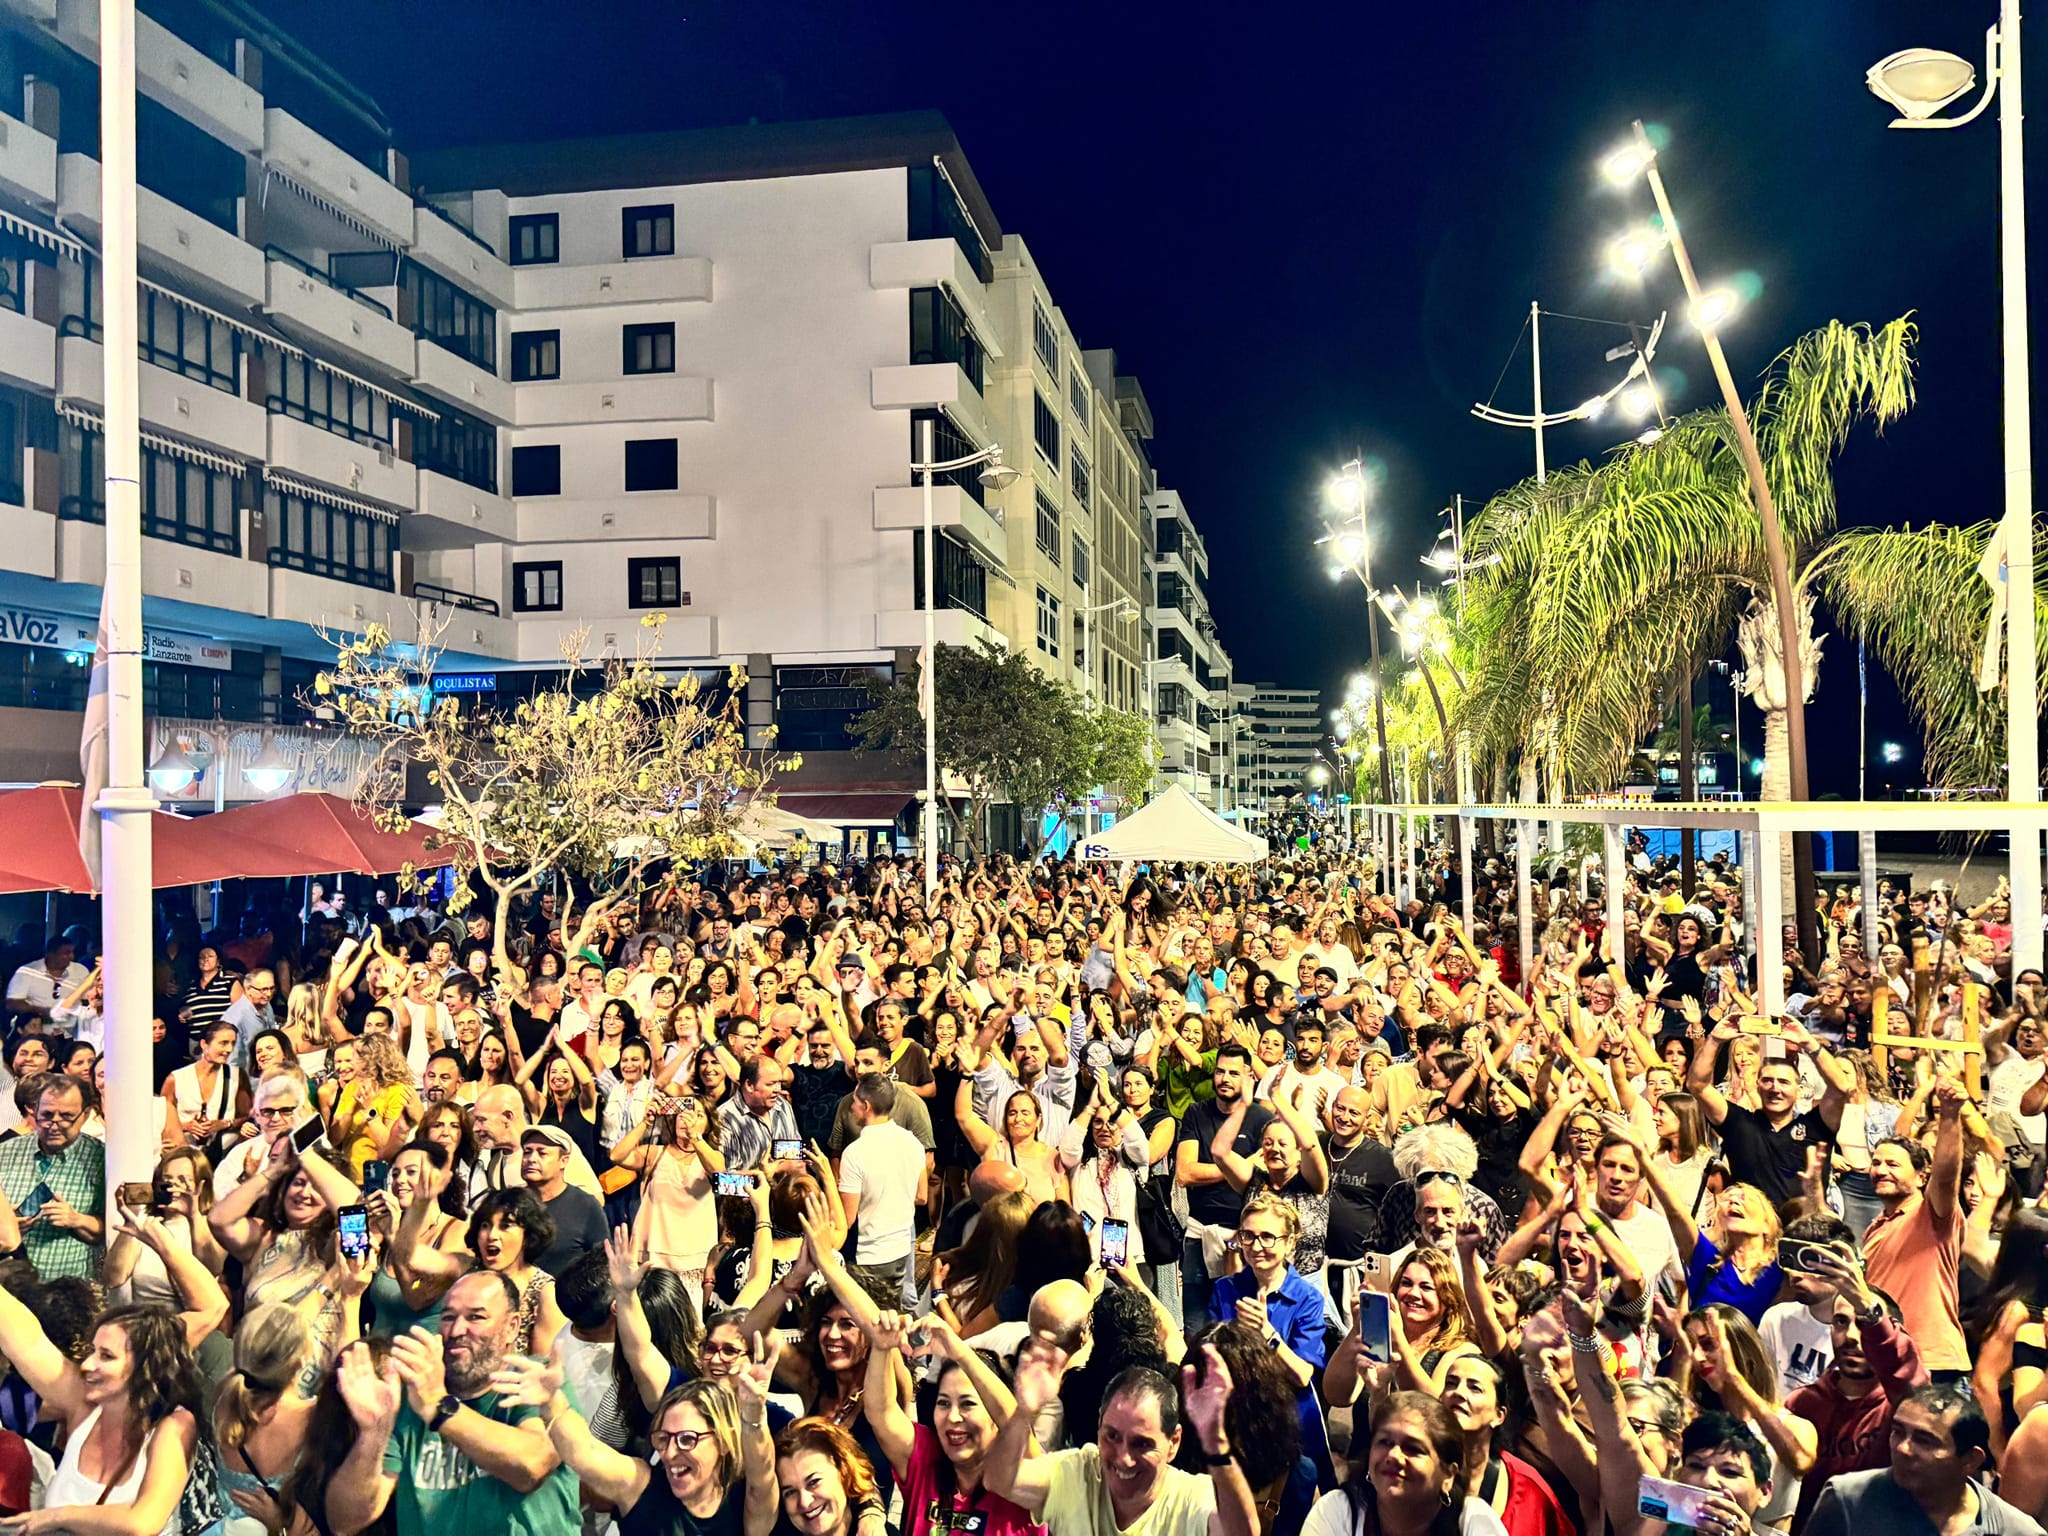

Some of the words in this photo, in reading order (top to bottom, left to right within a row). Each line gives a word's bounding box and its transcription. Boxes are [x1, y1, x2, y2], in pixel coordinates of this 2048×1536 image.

[152, 636, 175, 648] Radio
[152, 648, 192, 662] Lanzarote
[436, 678, 494, 689] OCULISTAS
